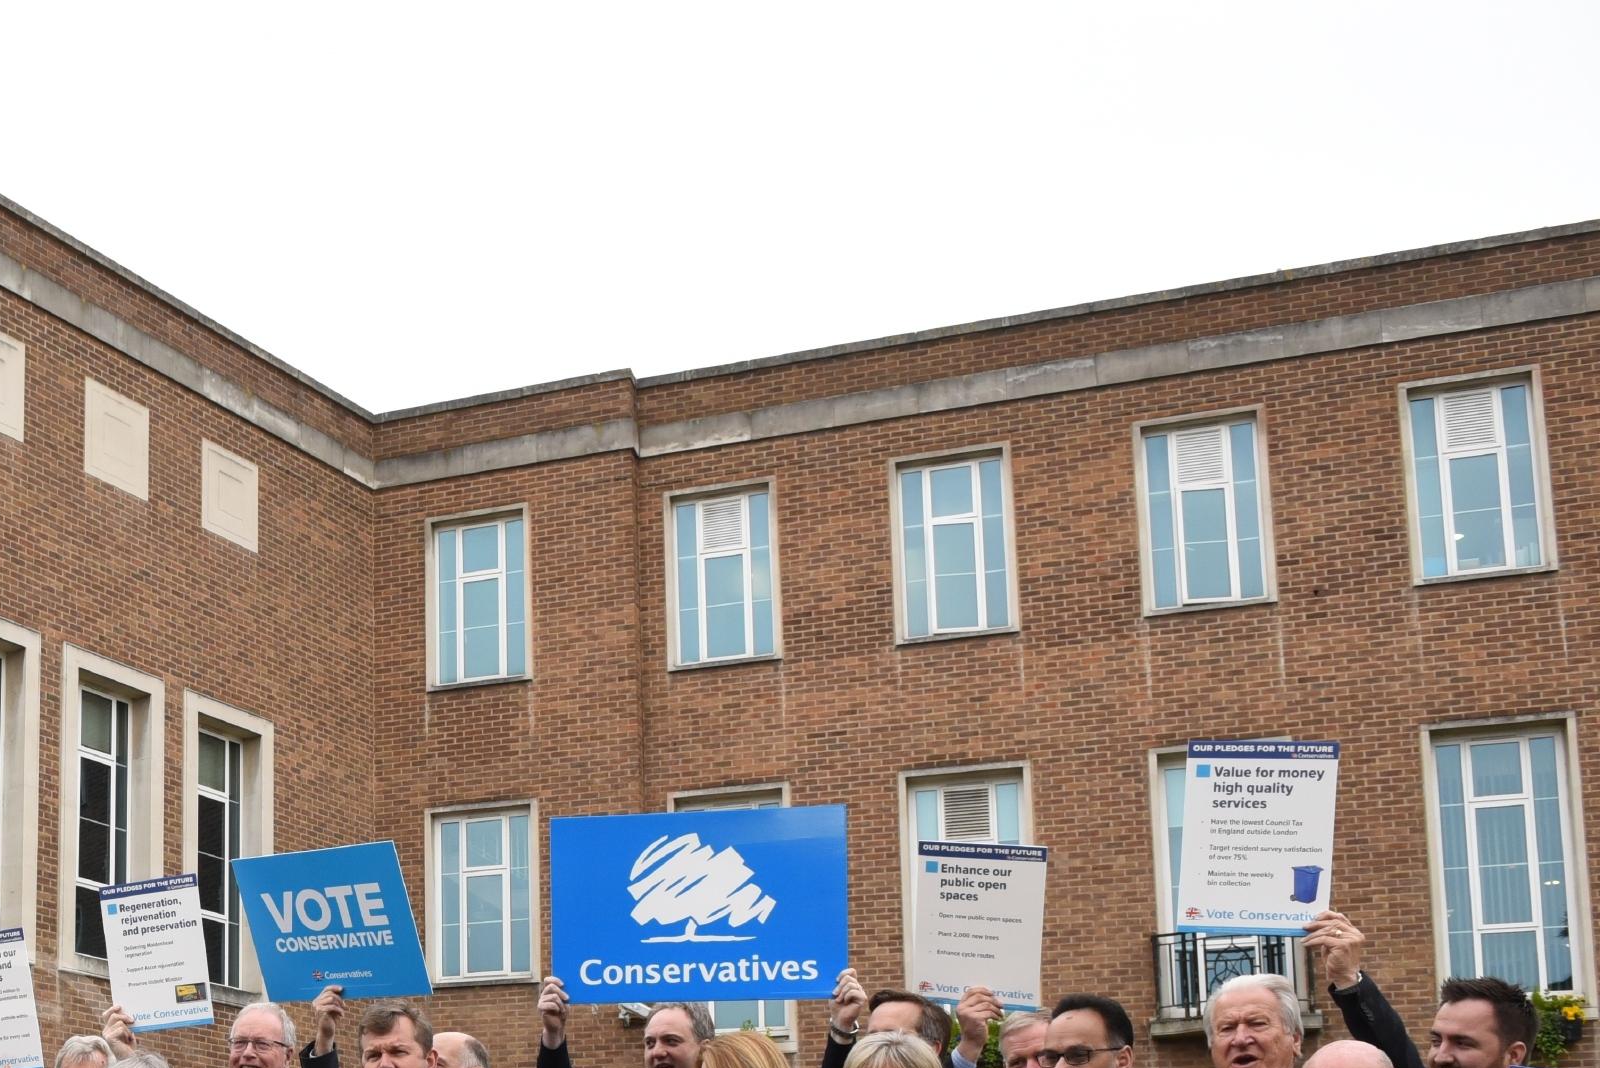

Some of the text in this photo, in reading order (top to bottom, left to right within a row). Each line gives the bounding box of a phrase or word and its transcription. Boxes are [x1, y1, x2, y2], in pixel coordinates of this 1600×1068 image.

[1214, 766, 1325, 781] Value for money
[1213, 782, 1293, 795] high quality
[1212, 798, 1267, 808] services
[941, 864, 1012, 877] Enhance our
[940, 877, 1006, 891] public open
[940, 890, 978, 901] spaces
[119, 898, 182, 913] Regeneration,
[260, 882, 389, 933] VOTE
[121, 910, 176, 925] rejuvenation
[122, 919, 197, 936] and preservation
[276, 930, 394, 953] CONSERVATIVE
[3, 949, 16, 957] our
[325, 970, 373, 979] Conservatives
[579, 954, 818, 985] Conservatives
